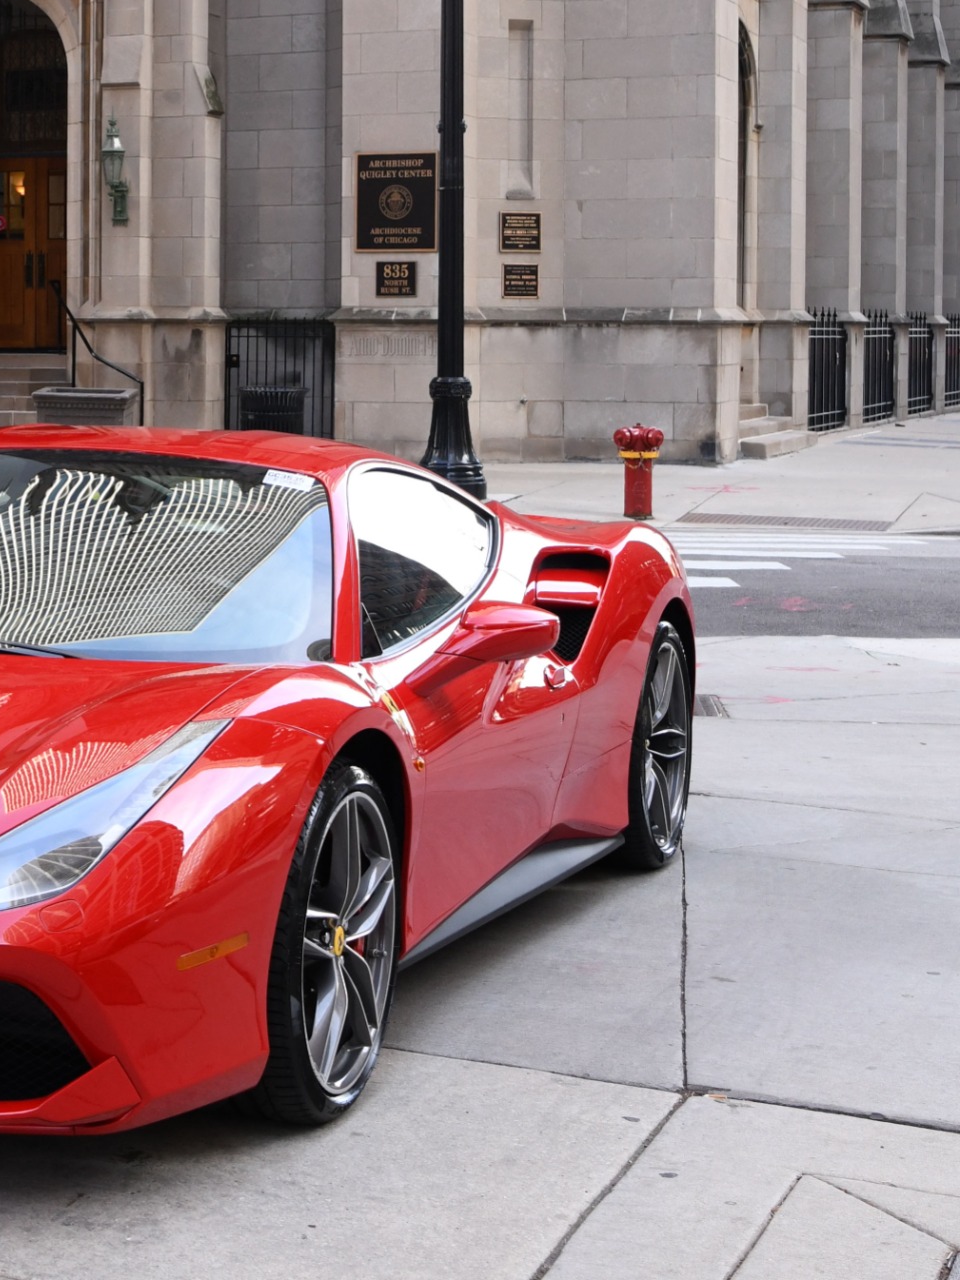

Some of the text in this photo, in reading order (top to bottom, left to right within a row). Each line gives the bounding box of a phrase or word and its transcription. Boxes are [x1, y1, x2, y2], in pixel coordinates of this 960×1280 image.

[368, 159, 424, 168] ARCHBISHOP
[359, 169, 433, 180] QUIGLEY CENTER
[370, 227, 422, 235] ARCHDIOCESE
[385, 236, 418, 244] CHICAGO
[383, 264, 409, 278] 835
